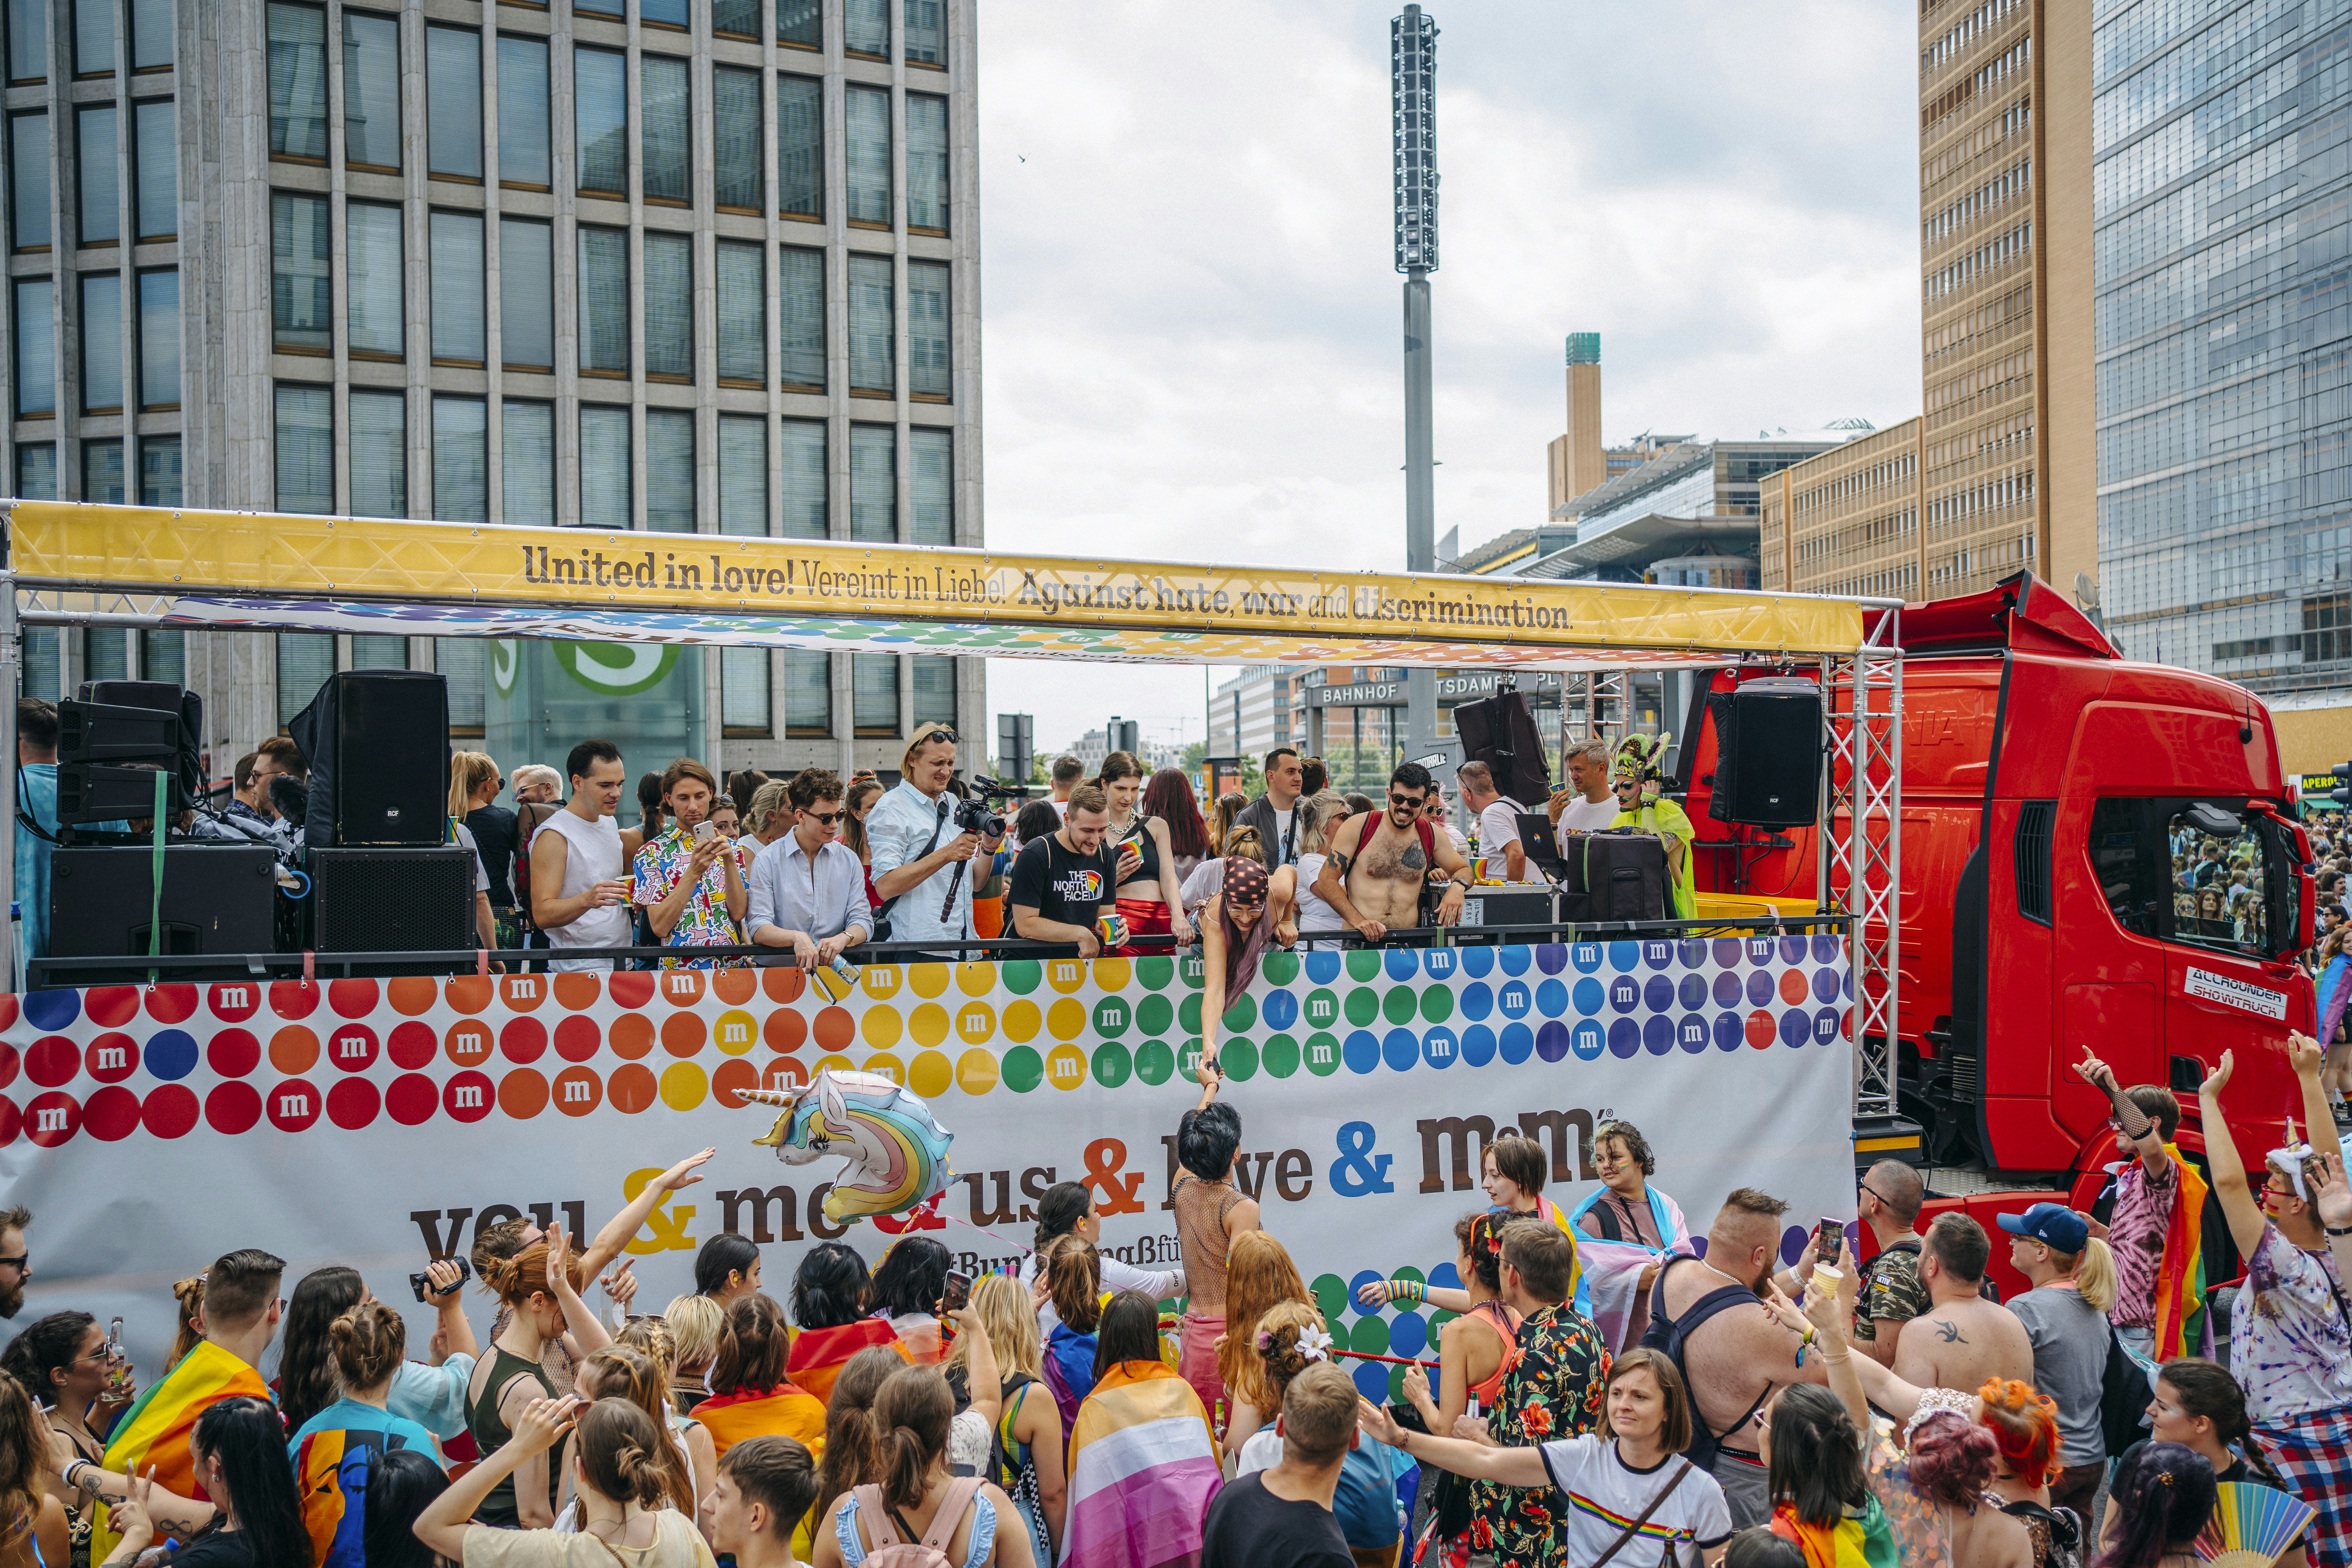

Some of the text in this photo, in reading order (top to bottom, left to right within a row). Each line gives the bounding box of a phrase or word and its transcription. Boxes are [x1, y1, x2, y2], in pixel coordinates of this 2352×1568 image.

[523, 545, 1573, 630] United in love! Vereint in Liebe! Against hate, war and discrimination.
[1323, 684, 1398, 702] BAHNHOF
[1436, 675, 1517, 694] TSDAME
[1069, 871, 1087, 881] THE
[1053, 880, 1088, 891] NORTH
[1064, 891, 1088, 901] FACE
[1579, 946, 1596, 962] m
[1650, 944, 1666, 959] m
[1752, 940, 1768, 955] m
[1432, 953, 1449, 968] m
[871, 969, 892, 987] m
[1056, 964, 1076, 981] m
[511, 979, 536, 998] m
[671, 975, 695, 993] m
[2192, 969, 2281, 1002] ALLROUNDER
[221, 987, 248, 1008] m
[1506, 992, 1523, 1007] m
[1617, 987, 1633, 1002] m
[2193, 985, 2276, 1017] SHOWTRUCK
[1312, 1000, 1330, 1016] m
[966, 1014, 986, 1032] m
[1102, 1009, 1122, 1026] m
[1818, 1018, 1833, 1034] m
[725, 1024, 747, 1042] m
[1580, 1031, 1597, 1048] m
[1685, 1025, 1702, 1042] m
[341, 1038, 367, 1057] m
[457, 1034, 482, 1053] m
[1431, 1039, 1450, 1056] m
[98, 1047, 126, 1069] m
[1312, 1045, 1332, 1063] m
[1056, 1058, 1077, 1076] m
[456, 1086, 483, 1107] m
[564, 1081, 590, 1102] m
[280, 1095, 309, 1117] m
[38, 1108, 67, 1131] m
[1079, 1138, 1145, 1218] &
[1161, 1135, 1313, 1211] lve
[1330, 1122, 1394, 1197] &
[624, 1168, 696, 1255] &
